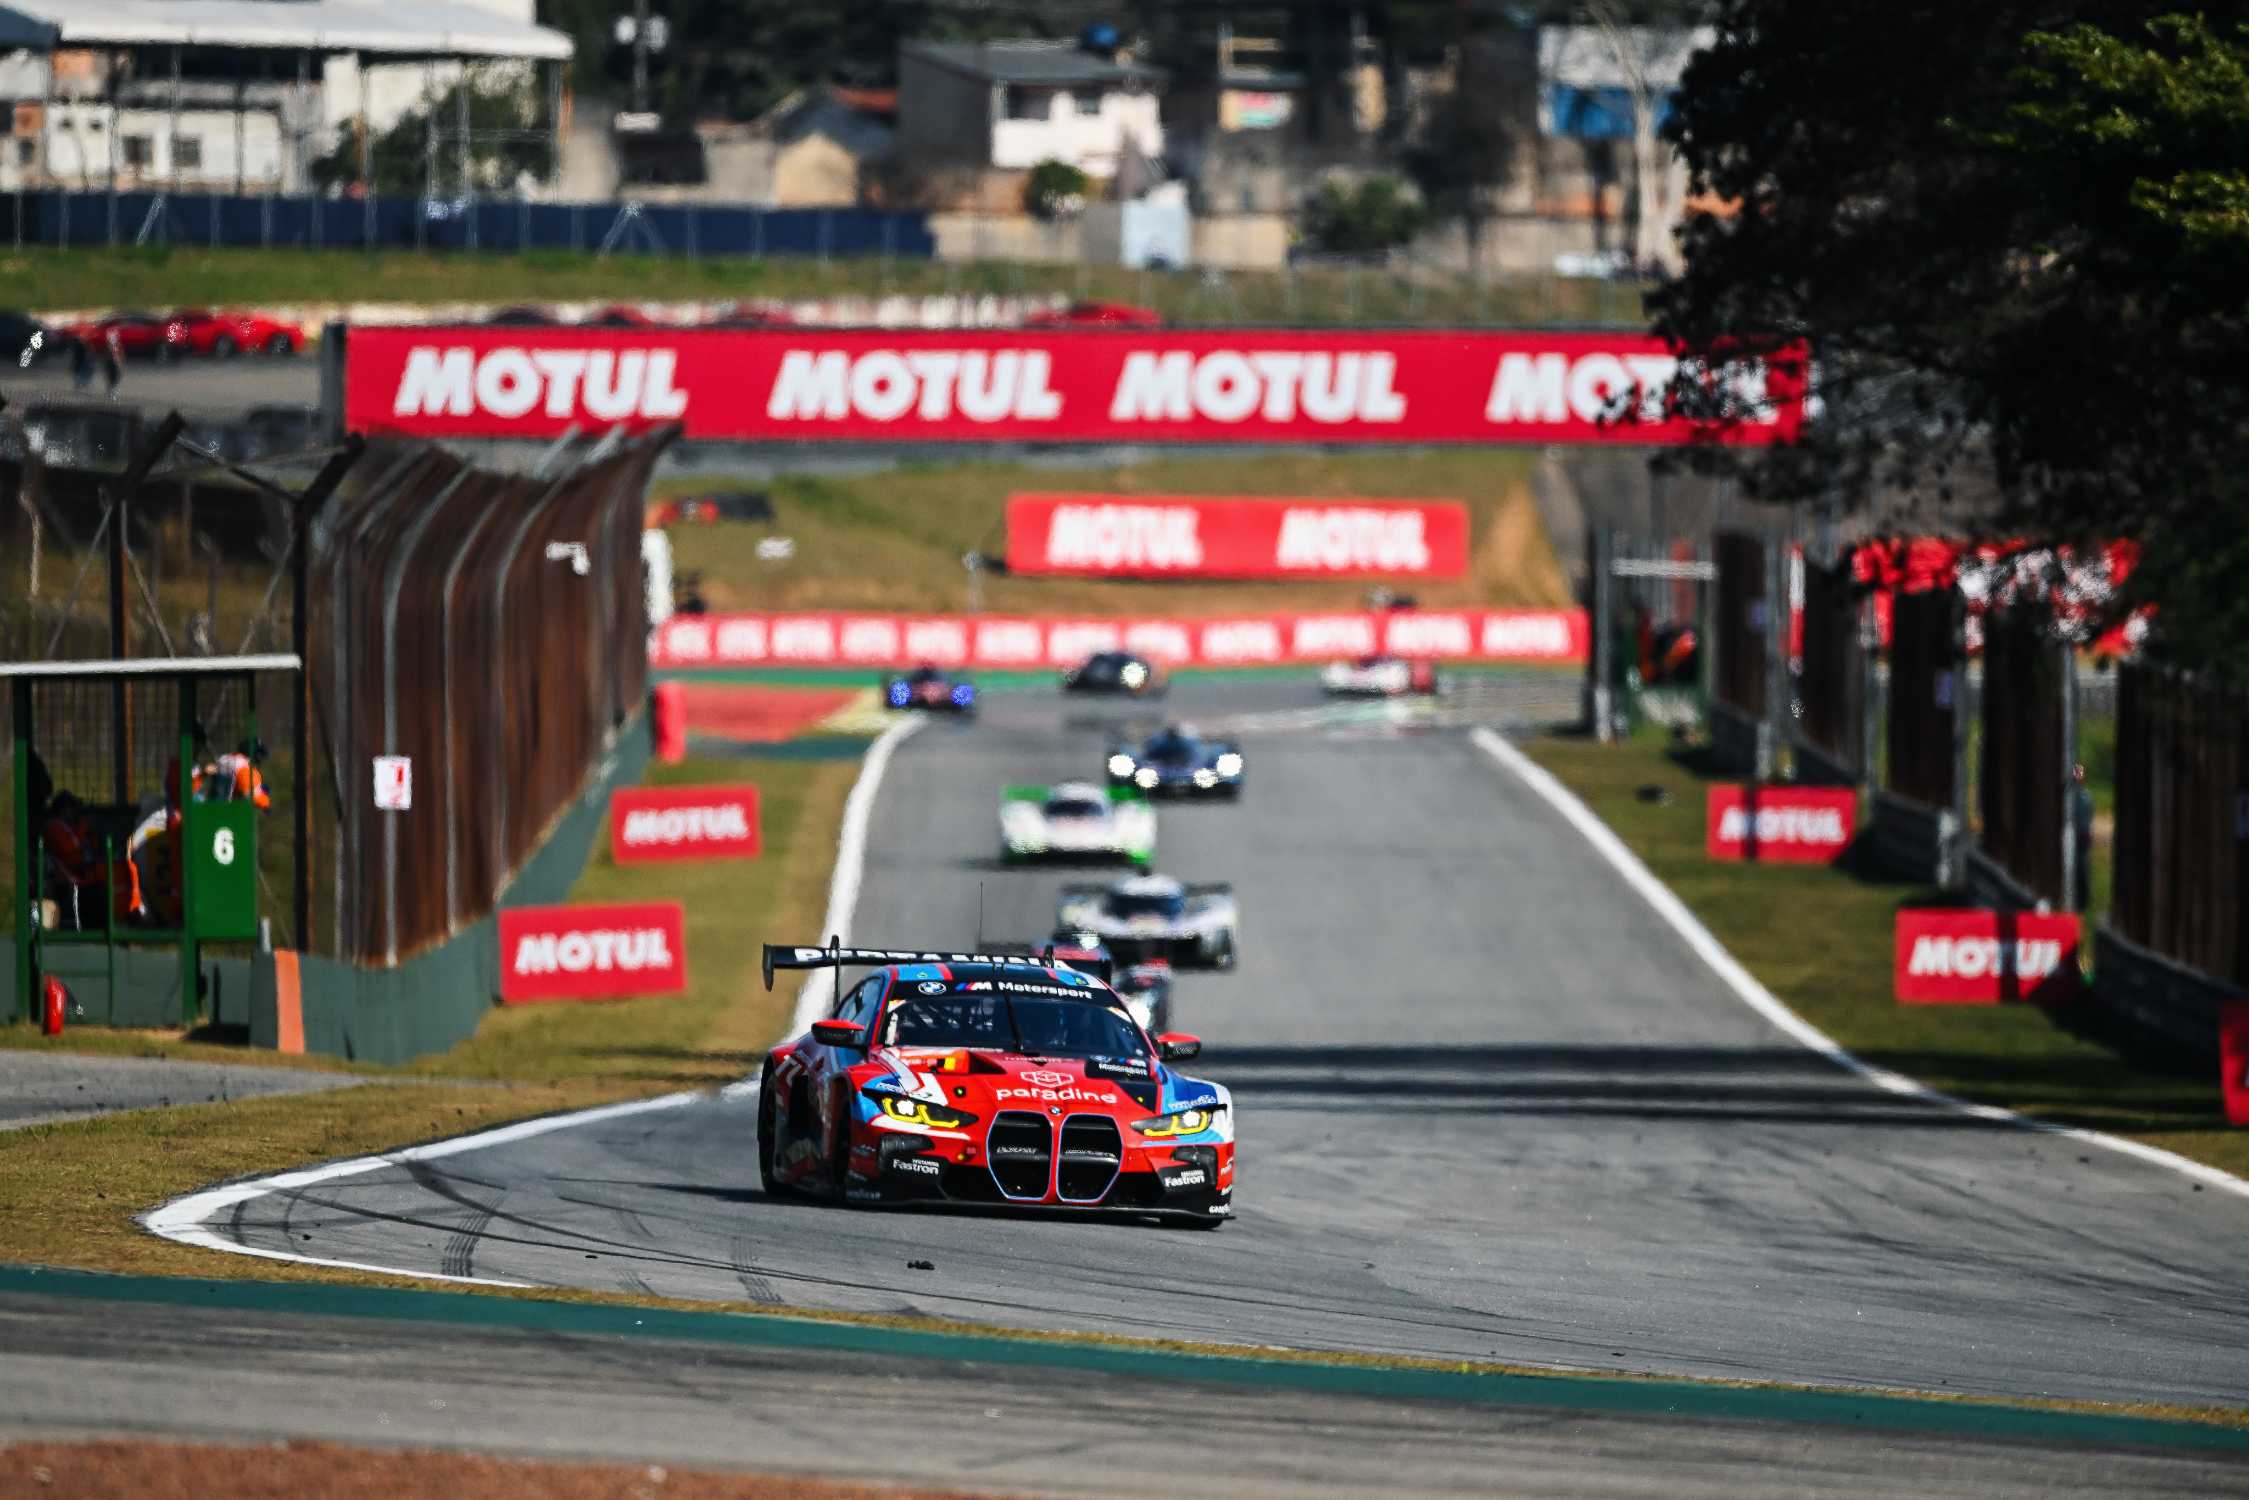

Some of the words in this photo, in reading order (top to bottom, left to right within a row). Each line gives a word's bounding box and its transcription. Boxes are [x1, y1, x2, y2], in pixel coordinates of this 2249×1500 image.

[395, 348, 688, 420] MOTUL
[768, 350, 1062, 422] MOTUL
[1111, 351, 1406, 422] MOTUL
[1486, 352, 1779, 424] MOTL
[1048, 504, 1203, 567] MOTUL
[1276, 509, 1430, 570] MOTUL
[623, 804, 750, 844] MOTUL
[1718, 805, 1847, 844] MOTUL
[213, 827, 235, 865] 6
[515, 929, 673, 974] MOTUL
[998, 982, 1092, 999] Motorsport
[996, 1087, 1118, 1104] paradine
[893, 1159, 940, 1176] Fastron
[1164, 1174, 1206, 1187] Fastron
